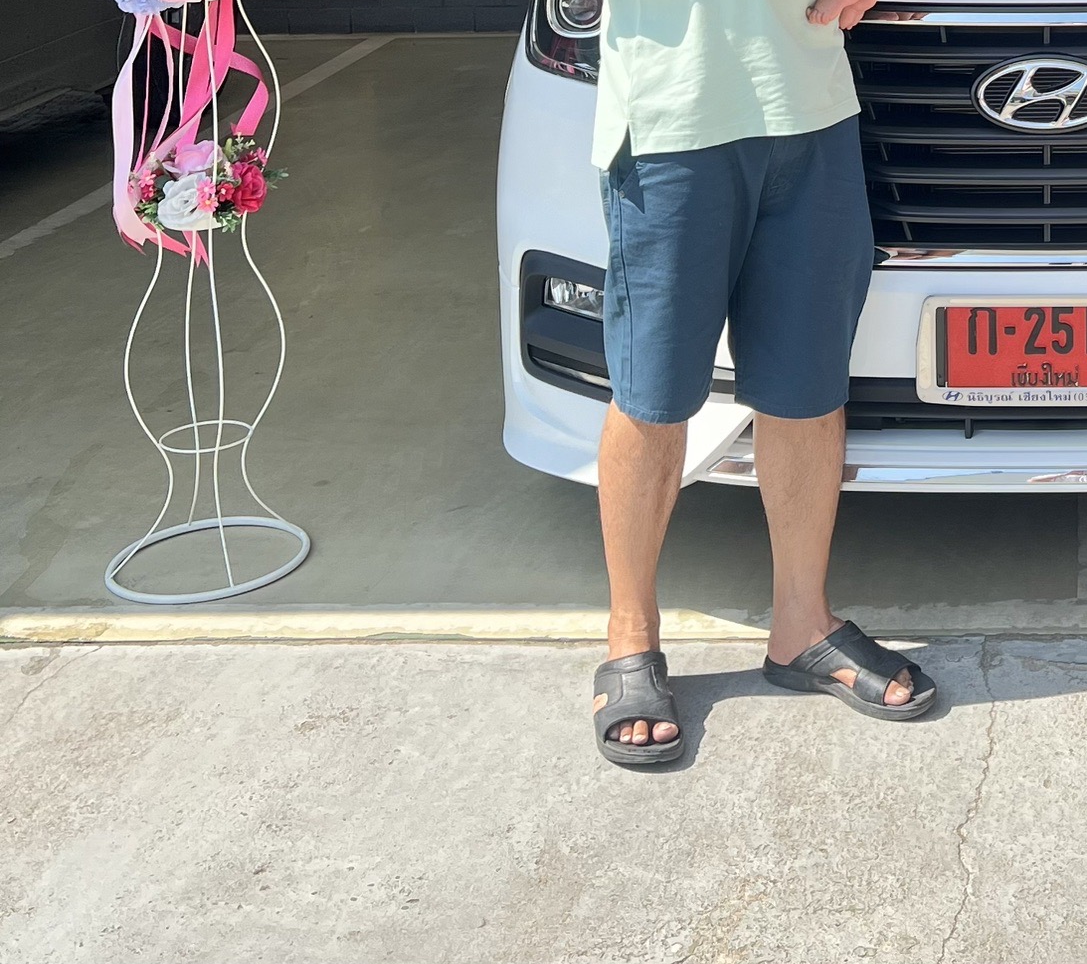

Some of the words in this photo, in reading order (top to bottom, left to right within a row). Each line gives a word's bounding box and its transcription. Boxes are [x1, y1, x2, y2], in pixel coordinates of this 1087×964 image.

[1011, 362, 1079, 387] เชียงใหม่
[966, 391, 1014, 404] นิธิบูรณ์
[1018, 390, 1072, 402] เชียงใหม่
